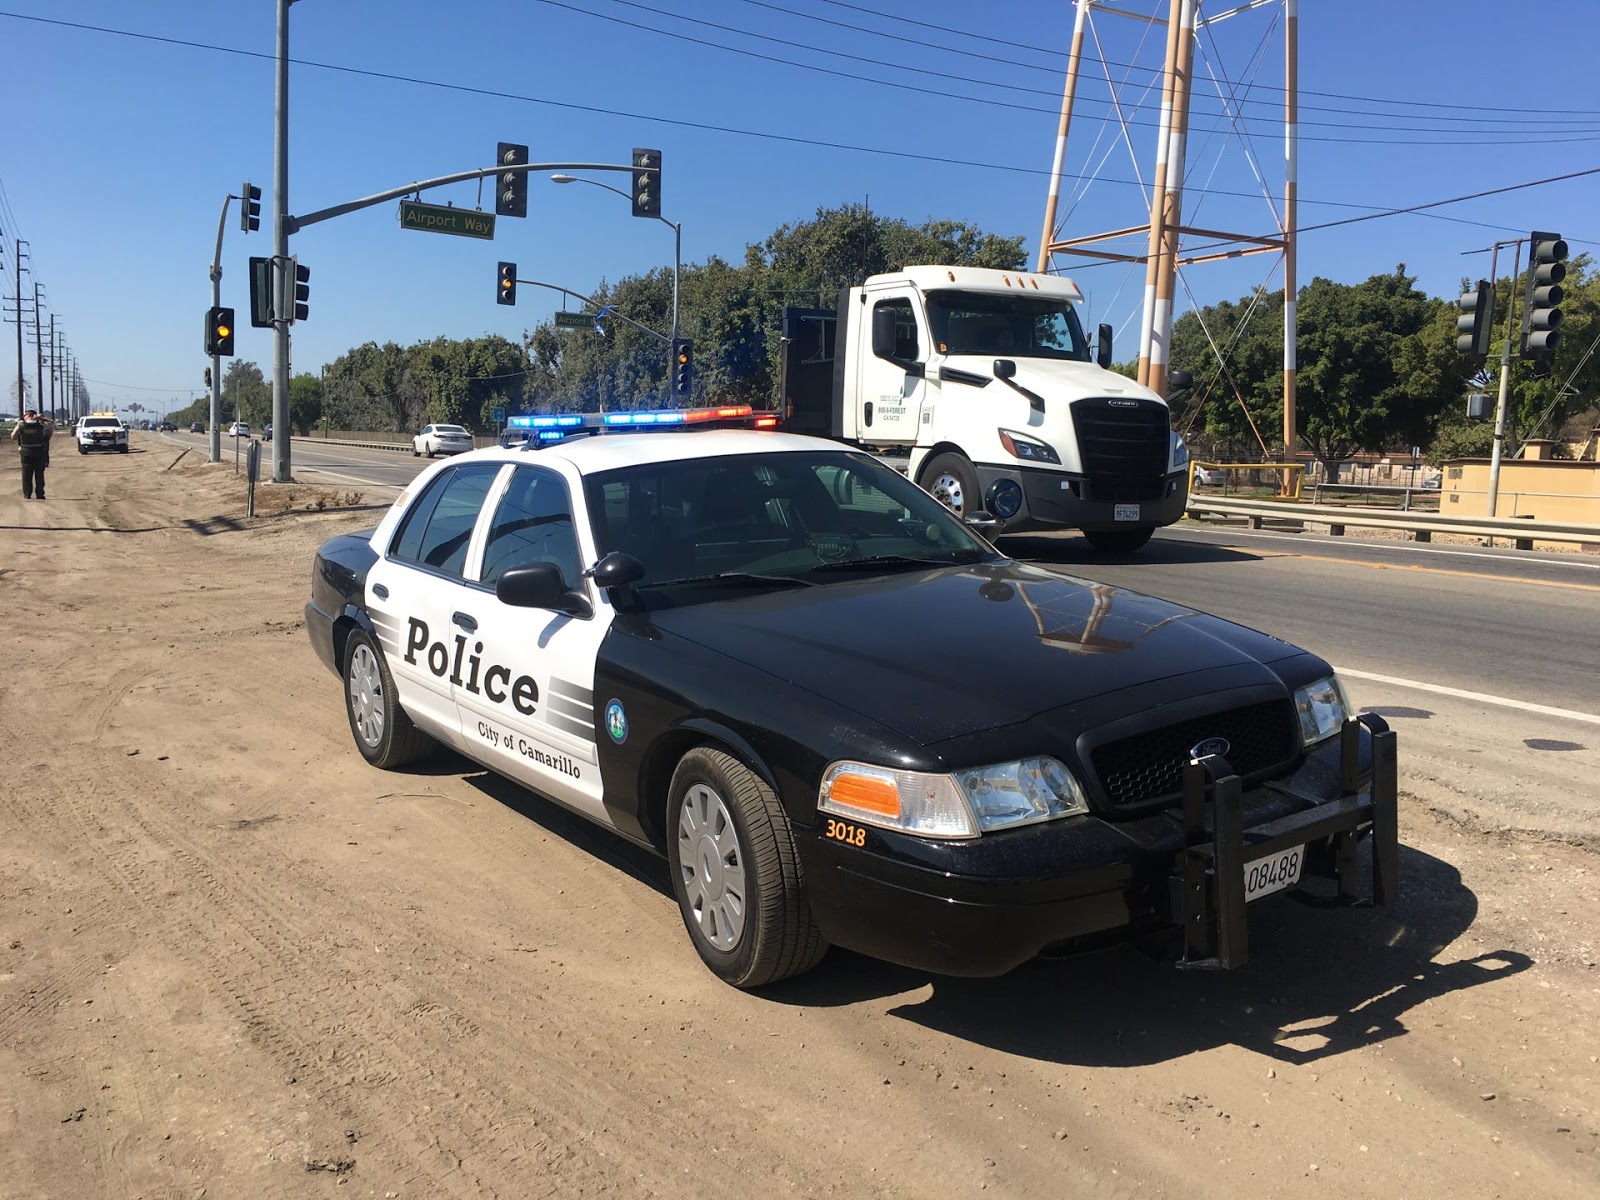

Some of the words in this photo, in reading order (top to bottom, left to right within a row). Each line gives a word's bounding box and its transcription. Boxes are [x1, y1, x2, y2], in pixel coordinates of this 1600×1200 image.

[406, 209, 456, 227] Airport
[464, 217, 491, 234] Way
[558, 315, 586, 325] Airport
[404, 616, 539, 716] Police
[477, 720, 500, 747] City
[503, 734, 515, 750] of
[518, 738, 581, 779] Camarillo
[825, 819, 866, 847] 3018
[1247, 852, 1299, 894] 08488
